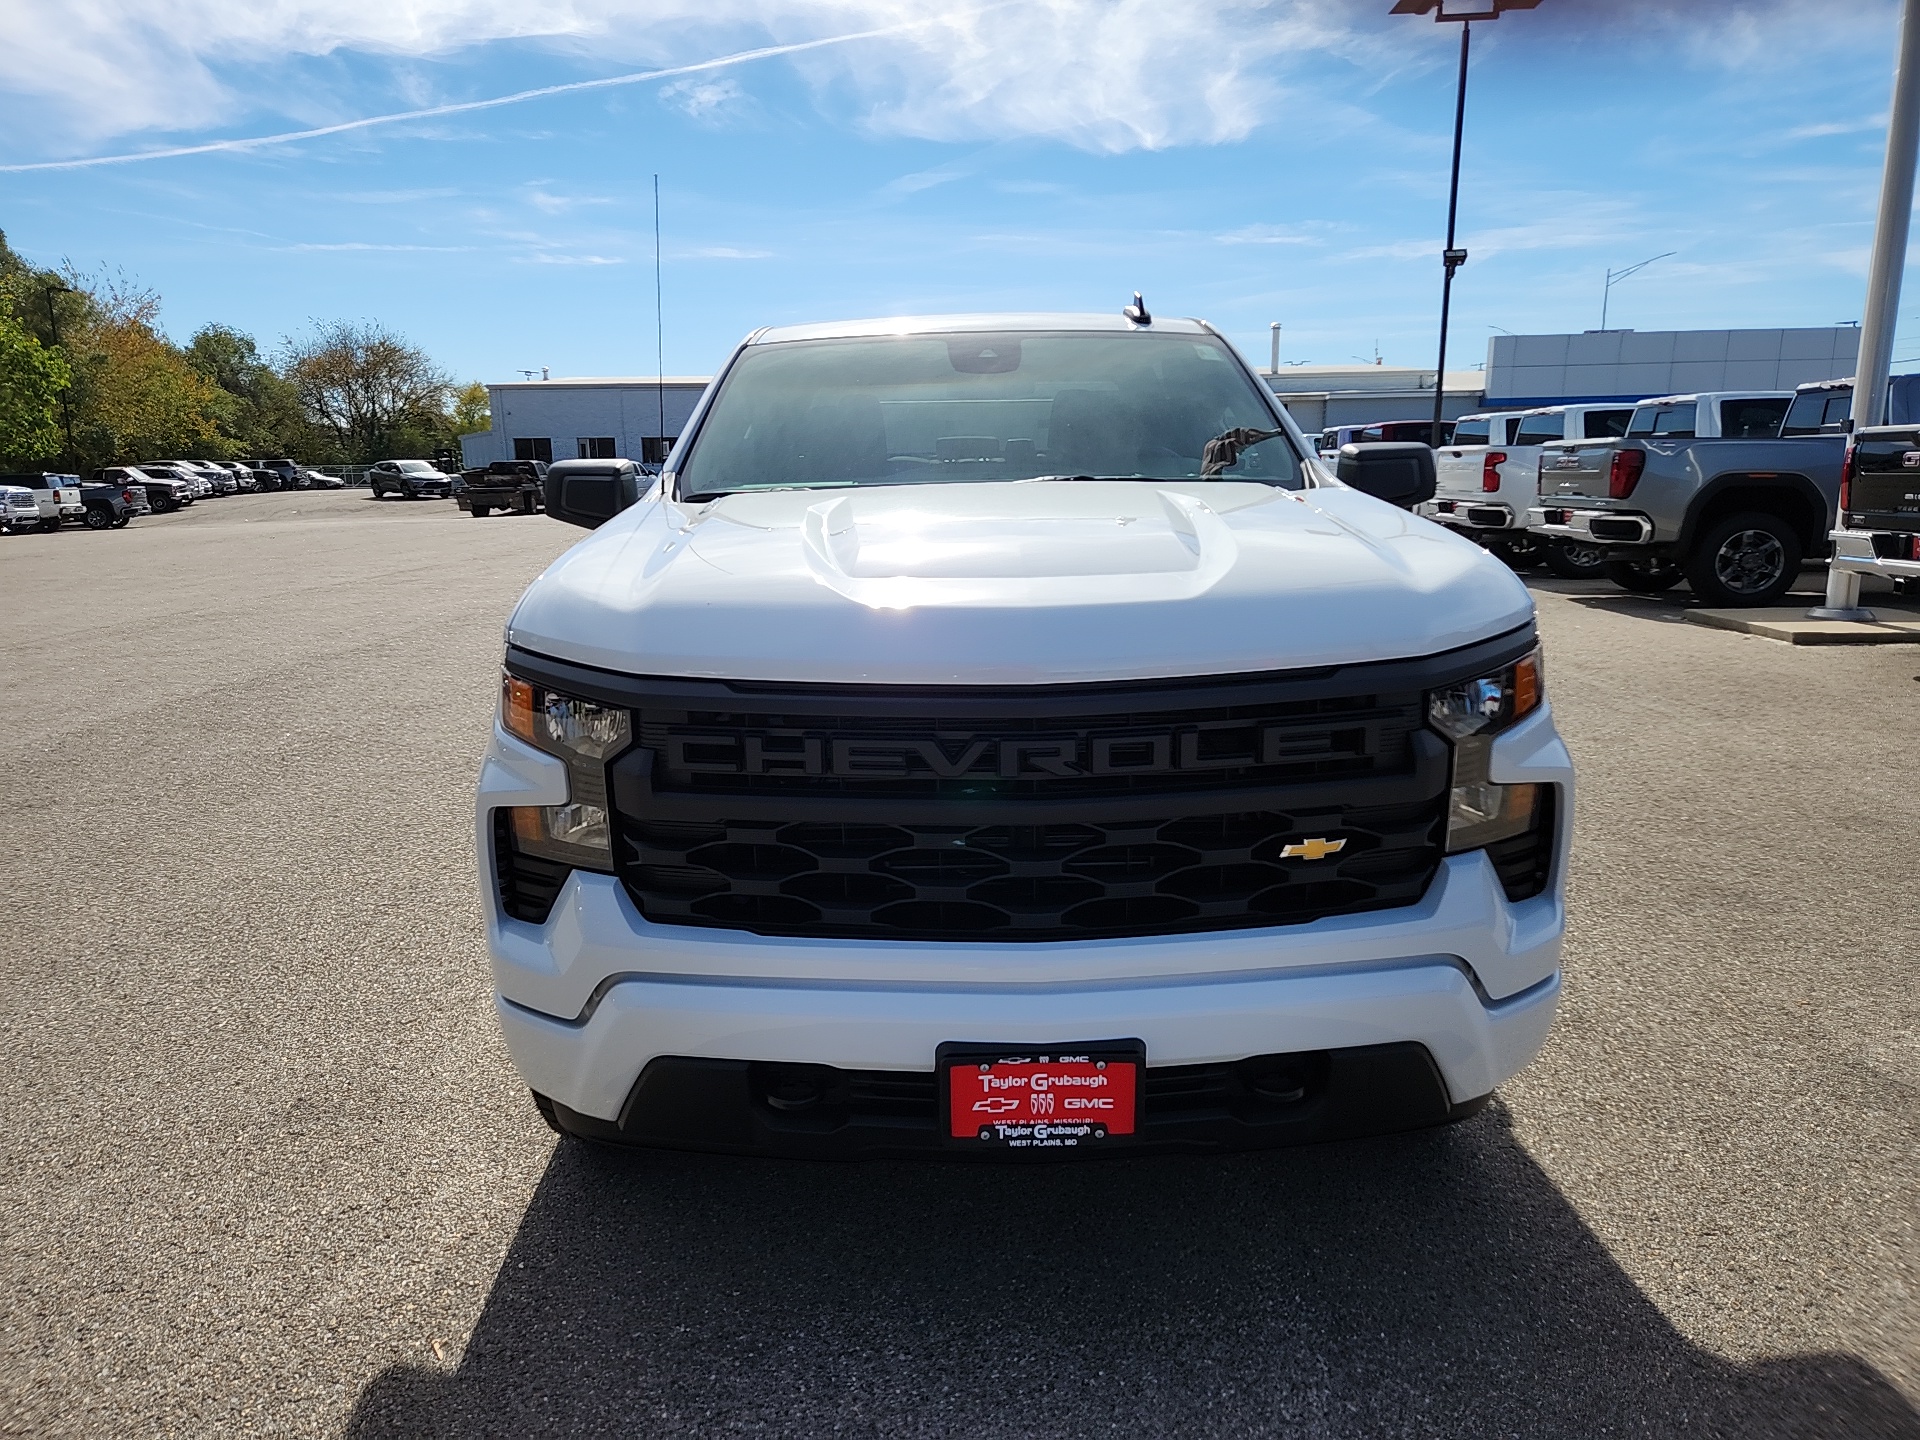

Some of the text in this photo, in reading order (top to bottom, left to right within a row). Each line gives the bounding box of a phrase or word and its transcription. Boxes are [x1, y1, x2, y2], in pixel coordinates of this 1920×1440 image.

[666, 714, 1404, 778] CHEVROLET
[978, 1073, 1108, 1092] Taylor Grubaugh
[1064, 1098, 1114, 1109] GMC
[1053, 1117, 1094, 1125] MISSOURI
[995, 1124, 1091, 1140] Taylor Grubaugh
[1009, 1139, 1032, 1147] WEST
[1064, 1138, 1078, 1146] MO
